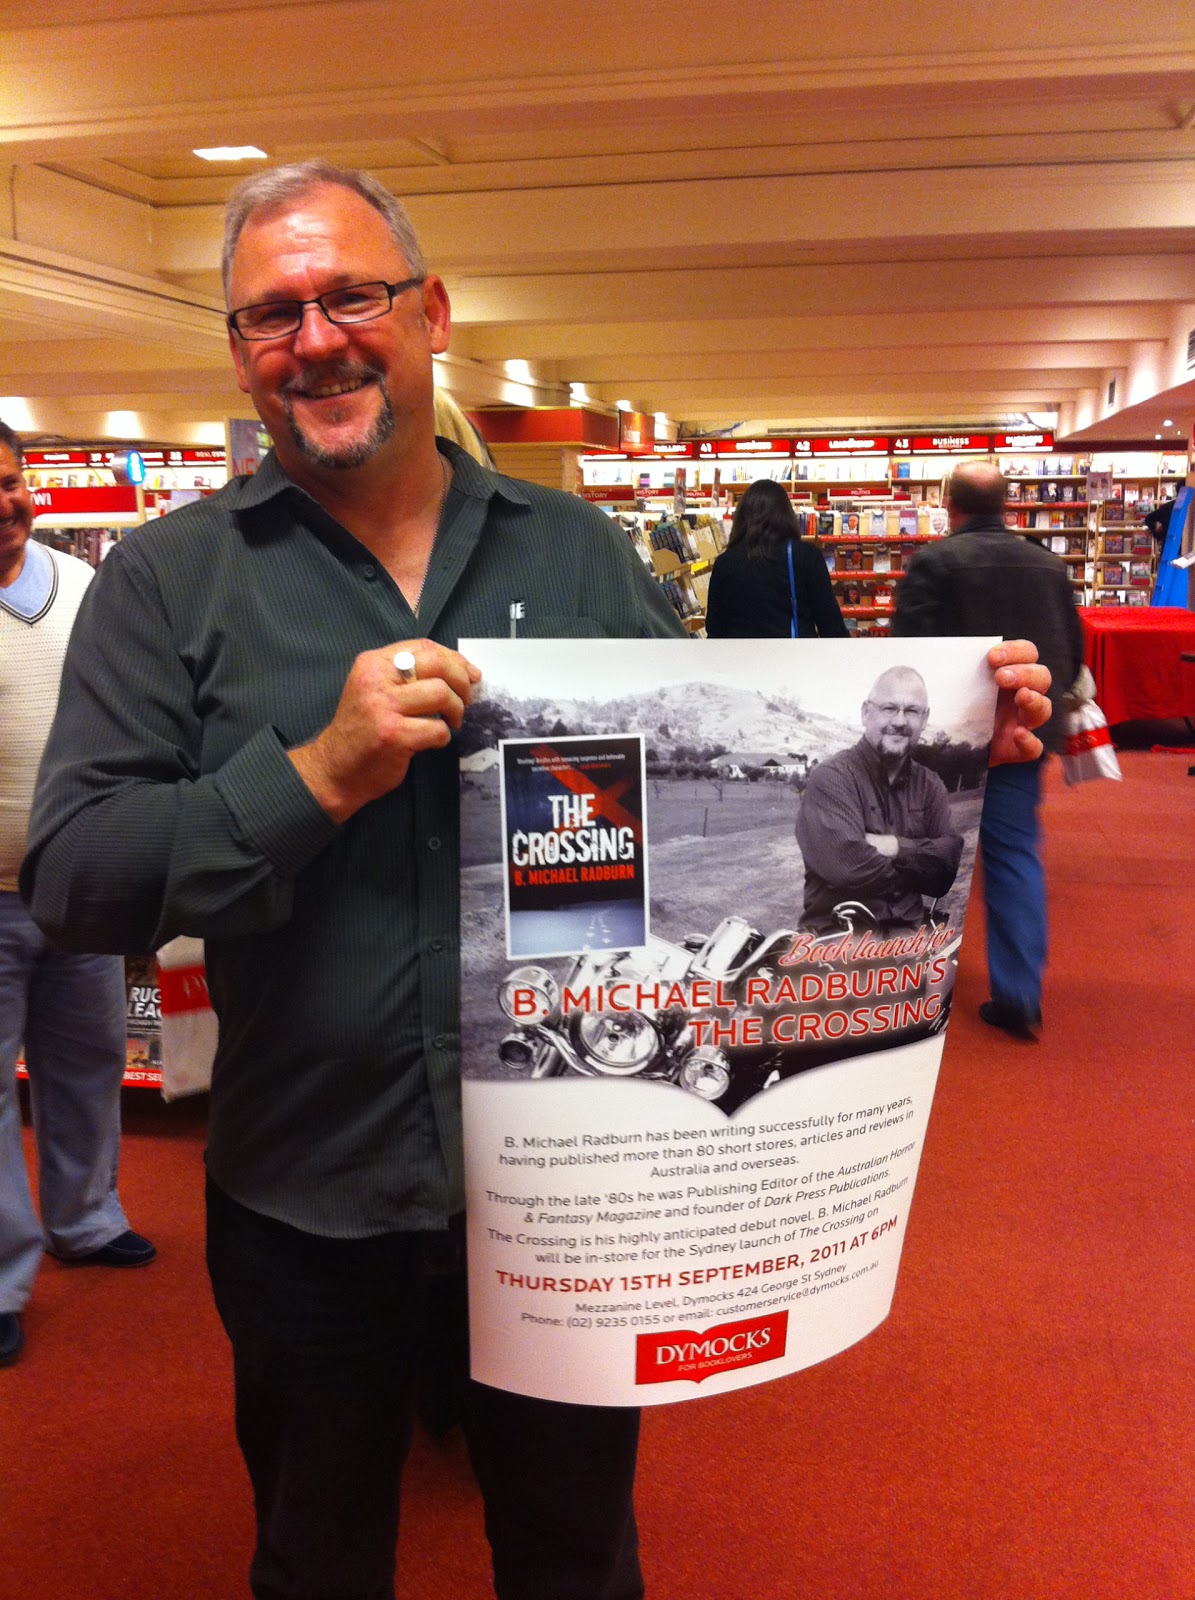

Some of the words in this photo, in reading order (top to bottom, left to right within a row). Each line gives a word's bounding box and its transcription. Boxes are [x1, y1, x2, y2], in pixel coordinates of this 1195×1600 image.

[932, 436, 970, 446] BUSINESS
[548, 793, 596, 828] THE
[512, 826, 634, 866] CROSSING
[514, 870, 527, 886] B.
[528, 868, 579, 885] MICHAEL
[580, 864, 635, 882] RADBURN
[778, 932, 854, 967] Book
[850, 924, 922, 961] launch
[920, 922, 954, 957] for
[513, 988, 549, 1017] B.
[562, 980, 736, 1015] MICHAEL
[747, 958, 947, 1006] RADBURN'S
[688, 1017, 763, 1048] THE
[771, 993, 941, 1044] CROSSING
[499, 1154, 545, 1168] having
[549, 1152, 620, 1168] published
[623, 1151, 659, 1163] more
[663, 1147, 693, 1159] than
[697, 1144, 715, 1157] 80
[718, 1142, 752, 1155] short
[755, 1139, 797, 1152] stores,
[800, 1130, 843, 1146] articles
[846, 1125, 866, 1139] and
[868, 1115, 904, 1133] reviews
[906, 1110, 914, 1119] in
[504, 1136, 518, 1148] B.
[523, 1136, 578, 1148] Michael
[582, 1133, 642, 1146] Radburn
[645, 1130, 669, 1142] has
[673, 1129, 707, 1141] been
[710, 1125, 755, 1138] writing
[759, 1114, 834, 1133] successfully
[837, 1111, 852, 1123] for
[856, 1105, 885, 1120] many
[887, 1096, 913, 1113] years,
[485, 1190, 544, 1208] Through
[547, 1194, 571, 1206] the
[574, 1193, 601, 1205] late
[637, 1191, 654, 1202] he
[657, 1189, 683, 1201] was
[687, 1180, 757, 1198] Publishing
[761, 1176, 798, 1191] Editor
[801, 1172, 814, 1185] of
[816, 1169, 834, 1182] the
[836, 1155, 888, 1176] Australian
[889, 1141, 915, 1161] Horror
[650, 1163, 710, 1178] Australia
[712, 1161, 738, 1174] and
[741, 1155, 800, 1171] overseas.
[487, 1228, 512, 1243] The
[516, 1233, 577, 1248] Crossing
[580, 1235, 591, 1246] is
[594, 1234, 615, 1246] his
[618, 1231, 661, 1245] highly
[664, 1222, 736, 1240] anticipated
[740, 1219, 776, 1233] debut
[818, 1205, 829, 1219] B.
[832, 1195, 872, 1215] Michael
[874, 1175, 909, 1201] Radburn
[523, 1212, 534, 1223] &
[537, 1212, 593, 1225] Fantasy
[596, 1209, 662, 1223] Magazine
[664, 1206, 690, 1218] and
[693, 1201, 744, 1216] founder
[749, 1199, 762, 1211] of
[764, 1193, 792, 1207] Dark
[795, 1188, 826, 1203] Press
[828, 1168, 891, 1196] Publications.
[496, 1270, 615, 1293] THURSDAY
[620, 1273, 671, 1291] 15TH
[678, 1254, 805, 1286] SEPTEMBER,
[810, 1240, 847, 1263] 2011
[849, 1231, 869, 1250] AT
[871, 1216, 898, 1241] 6PM
[535, 1252, 559, 1264] will
[563, 1252, 582, 1264] be
[585, 1249, 638, 1264] in-store
[641, 1248, 660, 1261] for
[663, 1245, 685, 1258] the
[689, 1241, 737, 1257] Sydney
[739, 1235, 781, 1250] launch
[784, 1229, 798, 1242] of
[799, 1226, 820, 1239] The
[822, 1212, 865, 1233] Crossing
[867, 1207, 879, 1220] on
[521, 1313, 564, 1326] Phone:
[566, 1316, 593, 1329] (02)
[596, 1316, 628, 1328] 9235
[630, 1315, 661, 1326] 0155
[663, 1314, 676, 1323] or
[678, 1309, 714, 1321] email:
[716, 1259, 879, 1317] customerservice@dymocks.com.au
[575, 1302, 642, 1314] Mezzanine
[683, 1287, 734, 1306] Dymocks
[737, 1286, 759, 1298] 424
[761, 1277, 799, 1295] George
[801, 1273, 812, 1284] St
[814, 1263, 847, 1281] Sydney
[656, 1328, 772, 1365] DYMOCKS
[678, 1363, 697, 1371] FOR
[698, 1351, 753, 1369] BOOKLOVERS
